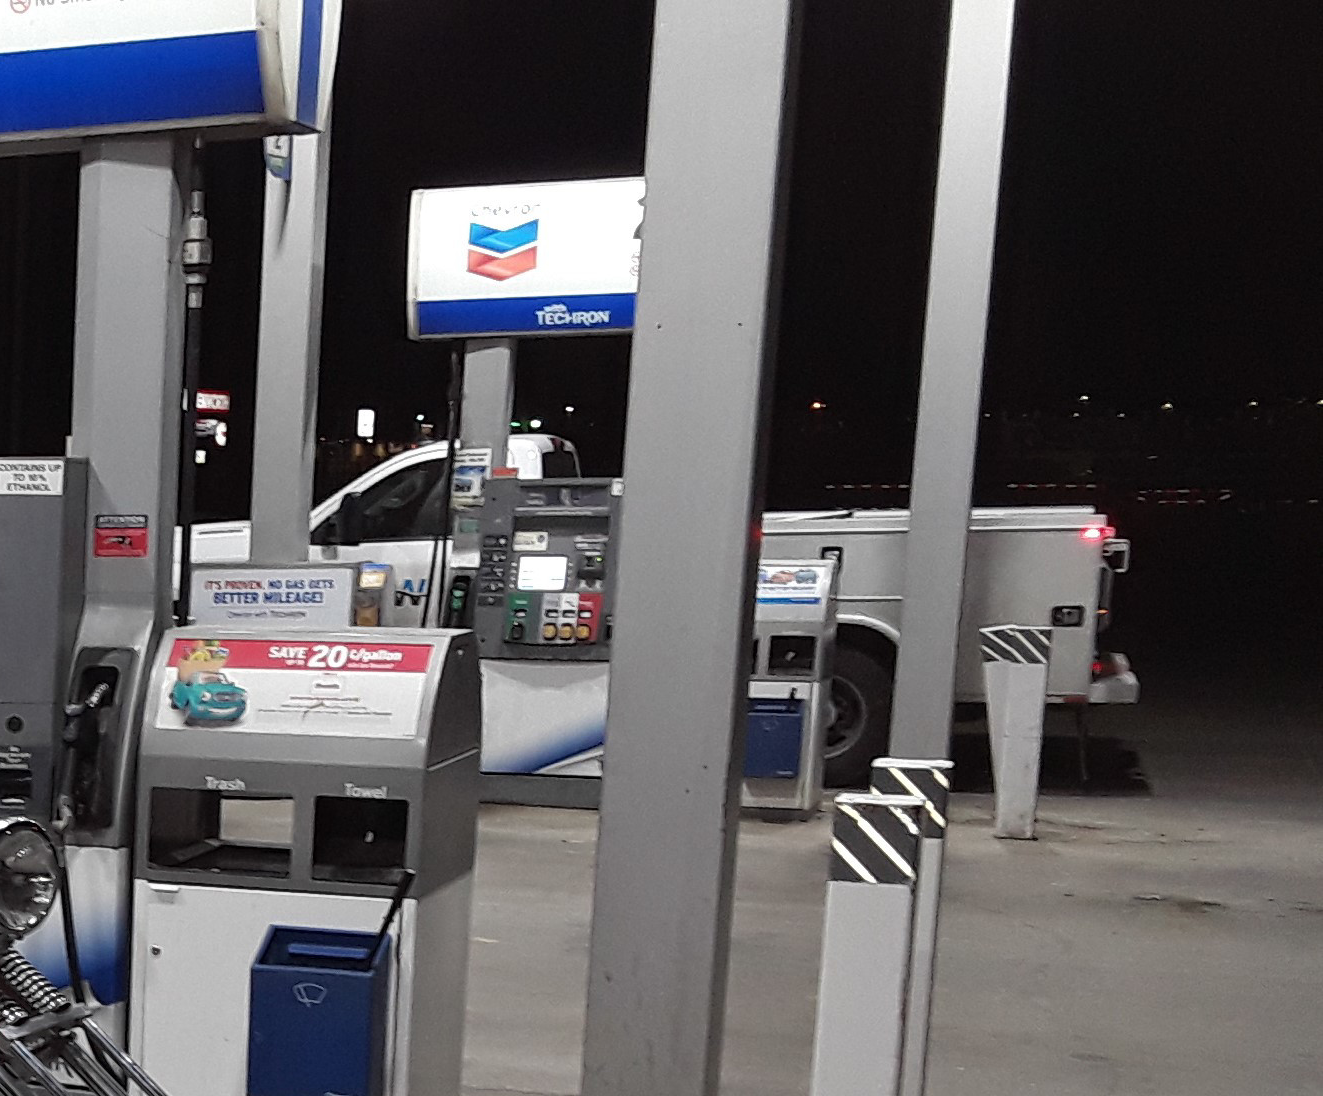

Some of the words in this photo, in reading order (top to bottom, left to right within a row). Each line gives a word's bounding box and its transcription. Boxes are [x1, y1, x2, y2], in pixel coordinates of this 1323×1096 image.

[534, 310, 611, 326] TECHRON
[48, 464, 62, 472] UP
[12, 473, 26, 482] TO
[6, 482, 52, 492] ETHANOL
[267, 579, 283, 589] NO
[285, 580, 306, 590] GAS
[308, 580, 334, 590] GETS
[213, 592, 259, 604] BETTER
[262, 592, 324, 604] MILEAGE!
[268, 646, 308, 660] SAVE
[307, 645, 348, 669] 20
[205, 775, 246, 791] Trash
[344, 783, 388, 799] Towel
